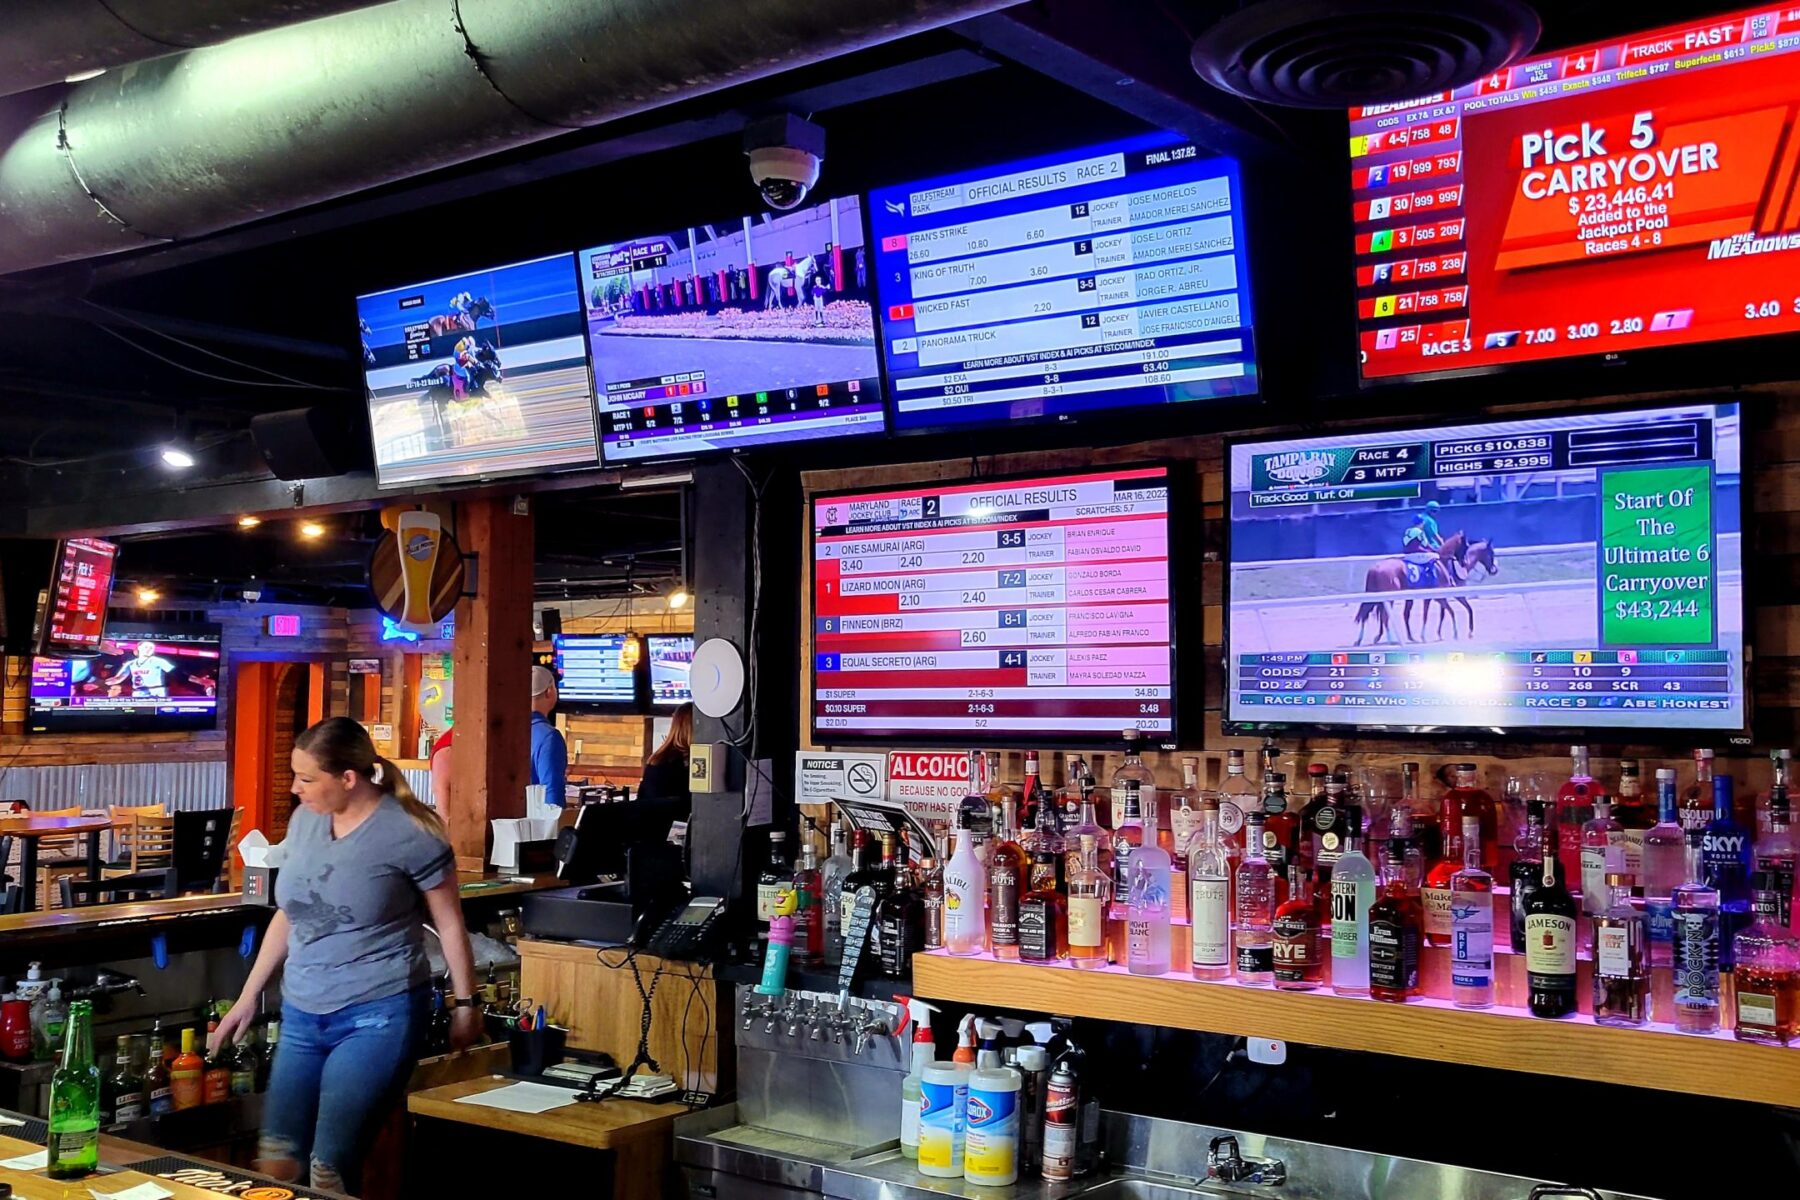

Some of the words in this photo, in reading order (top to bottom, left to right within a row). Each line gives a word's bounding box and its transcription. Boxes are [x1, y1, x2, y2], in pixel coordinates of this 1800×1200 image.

[1632, 40, 1673, 58] TRACK
[1685, 26, 1733, 50] FAST
[1464, 98, 1486, 111] POOL
[1488, 93, 1519, 106] TOTALS
[1562, 80, 1590, 92] Exacta
[1616, 66, 1647, 81] Trifecta
[1674, 53, 1722, 69] Superfecta
[1378, 117, 1399, 128] ODDS
[1388, 132, 1407, 144] 4-5
[1412, 129, 1430, 140] 758
[1438, 124, 1452, 135] 48
[1522, 122, 1607, 168] Pick
[1630, 112, 1654, 150] 5
[1146, 152, 1171, 166] FINAL
[1393, 166, 1406, 178] 19
[1413, 162, 1432, 174] 999
[1437, 158, 1456, 170] 793
[1522, 143, 1719, 200] CARRYOVER
[912, 188, 956, 204] GULFSTREAM
[968, 182, 1016, 200] OFFICIAL
[1018, 171, 1067, 192] RESULTS
[1077, 164, 1105, 180] RACE
[1092, 200, 1119, 212] JOCKEY
[1128, 195, 1150, 207] JOSE
[1152, 186, 1197, 203] MORELOS
[1415, 194, 1434, 206] 999
[1439, 190, 1458, 202] 999
[1584, 182, 1674, 213] 23,446.41
[912, 204, 931, 215] PARK
[1094, 216, 1122, 228] TRAINER
[1190, 197, 1229, 212] SANCHEZ
[1578, 210, 1623, 226] Added
[1626, 208, 1639, 220] to
[1644, 202, 1667, 216] the
[940, 226, 968, 240] STRIKE
[1026, 230, 1044, 240] 6.60
[1416, 228, 1435, 240] 505
[1440, 224, 1459, 236] 209
[1576, 222, 1633, 242] Jackpot
[1636, 214, 1668, 230] Pool
[1731, 232, 1755, 244] THE
[632, 246, 649, 257] RACE
[650, 243, 665, 254] MTP
[1585, 240, 1628, 255] Races
[1707, 234, 1800, 260] MEADOWS
[914, 269, 934, 280] KING
[948, 263, 975, 276] TRUTH
[1030, 266, 1048, 276] 3.60
[1418, 262, 1436, 274] 758
[1442, 258, 1461, 270] 238
[1178, 280, 1209, 292] ABREU
[917, 302, 949, 314] WICKED
[950, 299, 970, 310] FAST
[1034, 302, 1052, 313] 2.20
[1138, 305, 1168, 320] JAVIER
[1170, 299, 1230, 316] CASTELLANO
[1399, 298, 1412, 310] 21
[1420, 294, 1438, 306] 758
[1401, 330, 1416, 342] 25
[1422, 340, 1460, 356] RACE
[1526, 328, 1556, 345] 7.00
[1567, 323, 1599, 341] 3.00
[1610, 318, 1643, 335] 2.80
[1744, 301, 1780, 320] 3.60
[920, 335, 966, 348] PANORAMA
[968, 330, 997, 343] TRUCK
[1142, 362, 1169, 373] 63.40
[1144, 374, 1172, 384] 108.60
[626, 422, 633, 430] 11
[1264, 452, 1306, 472] TAMPA
[1311, 452, 1336, 468] BAY
[1358, 451, 1390, 461] RACE
[1440, 443, 1482, 456] PICK6
[1376, 468, 1407, 478] MTP
[1440, 460, 1483, 472] HIGH5
[849, 500, 890, 512] MARYLAND
[901, 498, 922, 507] RACE
[970, 492, 1022, 508] OFFICIAL
[1024, 489, 1077, 505] RESULTS
[1114, 492, 1132, 502] MAR
[1146, 488, 1168, 499] 2022
[1614, 492, 1663, 511] Start
[1669, 488, 1695, 508] Of
[1636, 518, 1675, 536] The
[842, 544, 860, 555] ONE
[861, 542, 900, 554] SAMURAI
[901, 540, 926, 552] (ARG)
[1002, 533, 1021, 545] 3-5
[842, 560, 863, 572] 3.40
[900, 556, 922, 568] 2.40
[962, 552, 985, 564] 2.20
[1604, 545, 1690, 565] Ultimate
[1696, 543, 1710, 561] 6
[842, 581, 872, 592] LIZARD
[873, 580, 901, 591] MOON
[902, 578, 926, 590] (ARG)
[1004, 574, 1021, 586] 7-2
[1606, 574, 1708, 595] Carryover
[900, 594, 920, 606] 2.10
[962, 592, 986, 604] 2.40
[1615, 600, 1698, 620] $43,244
[842, 620, 880, 630] FINNEON
[881, 618, 904, 630] (BRZ)
[1004, 614, 1021, 625] 8-1
[962, 631, 986, 643] 2.60
[842, 657, 870, 668] EQUAL
[872, 656, 912, 668] SECRETO
[913, 656, 937, 667] (ARG)
[1004, 654, 1022, 665] 4-1
[1262, 668, 1300, 677] ODDS
[1572, 668, 1592, 677] 10
[1134, 688, 1159, 697] 34.80
[1526, 682, 1549, 690] 136
[1568, 682, 1592, 690] 268
[1612, 682, 1638, 690] SCR
[1140, 704, 1160, 713] 3.48
[1264, 696, 1303, 705] RACE
[1526, 698, 1572, 707] RACE
[806, 760, 838, 770] NOTICE
[890, 752, 985, 778] 'ALCOHO
[900, 786, 935, 796] BECAUSE
[938, 786, 948, 796] NO
[904, 802, 928, 812] STORY
[930, 802, 946, 812] HAS
[1703, 834, 1744, 852] SKYY
[1129, 921, 1150, 929] MONT
[1374, 926, 1392, 936] Evan
[1527, 918, 1572, 932] JAMESON
[1370, 934, 1398, 945] Williams
[1273, 944, 1306, 959] RYE
